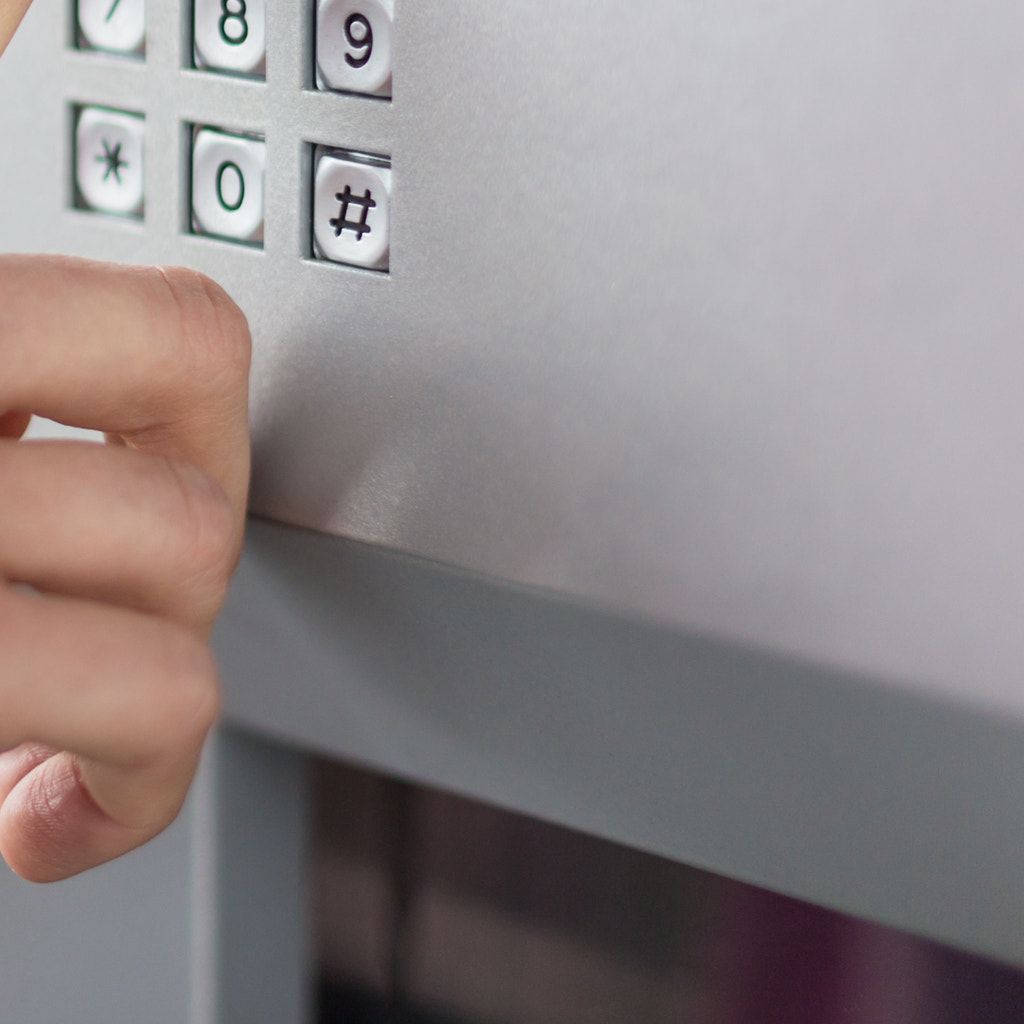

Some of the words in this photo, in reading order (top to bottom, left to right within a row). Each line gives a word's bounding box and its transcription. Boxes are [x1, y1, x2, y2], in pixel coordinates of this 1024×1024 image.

[342, 11, 374, 70] 9
[214, 159, 246, 213] 0
[328, 183, 377, 242] #
